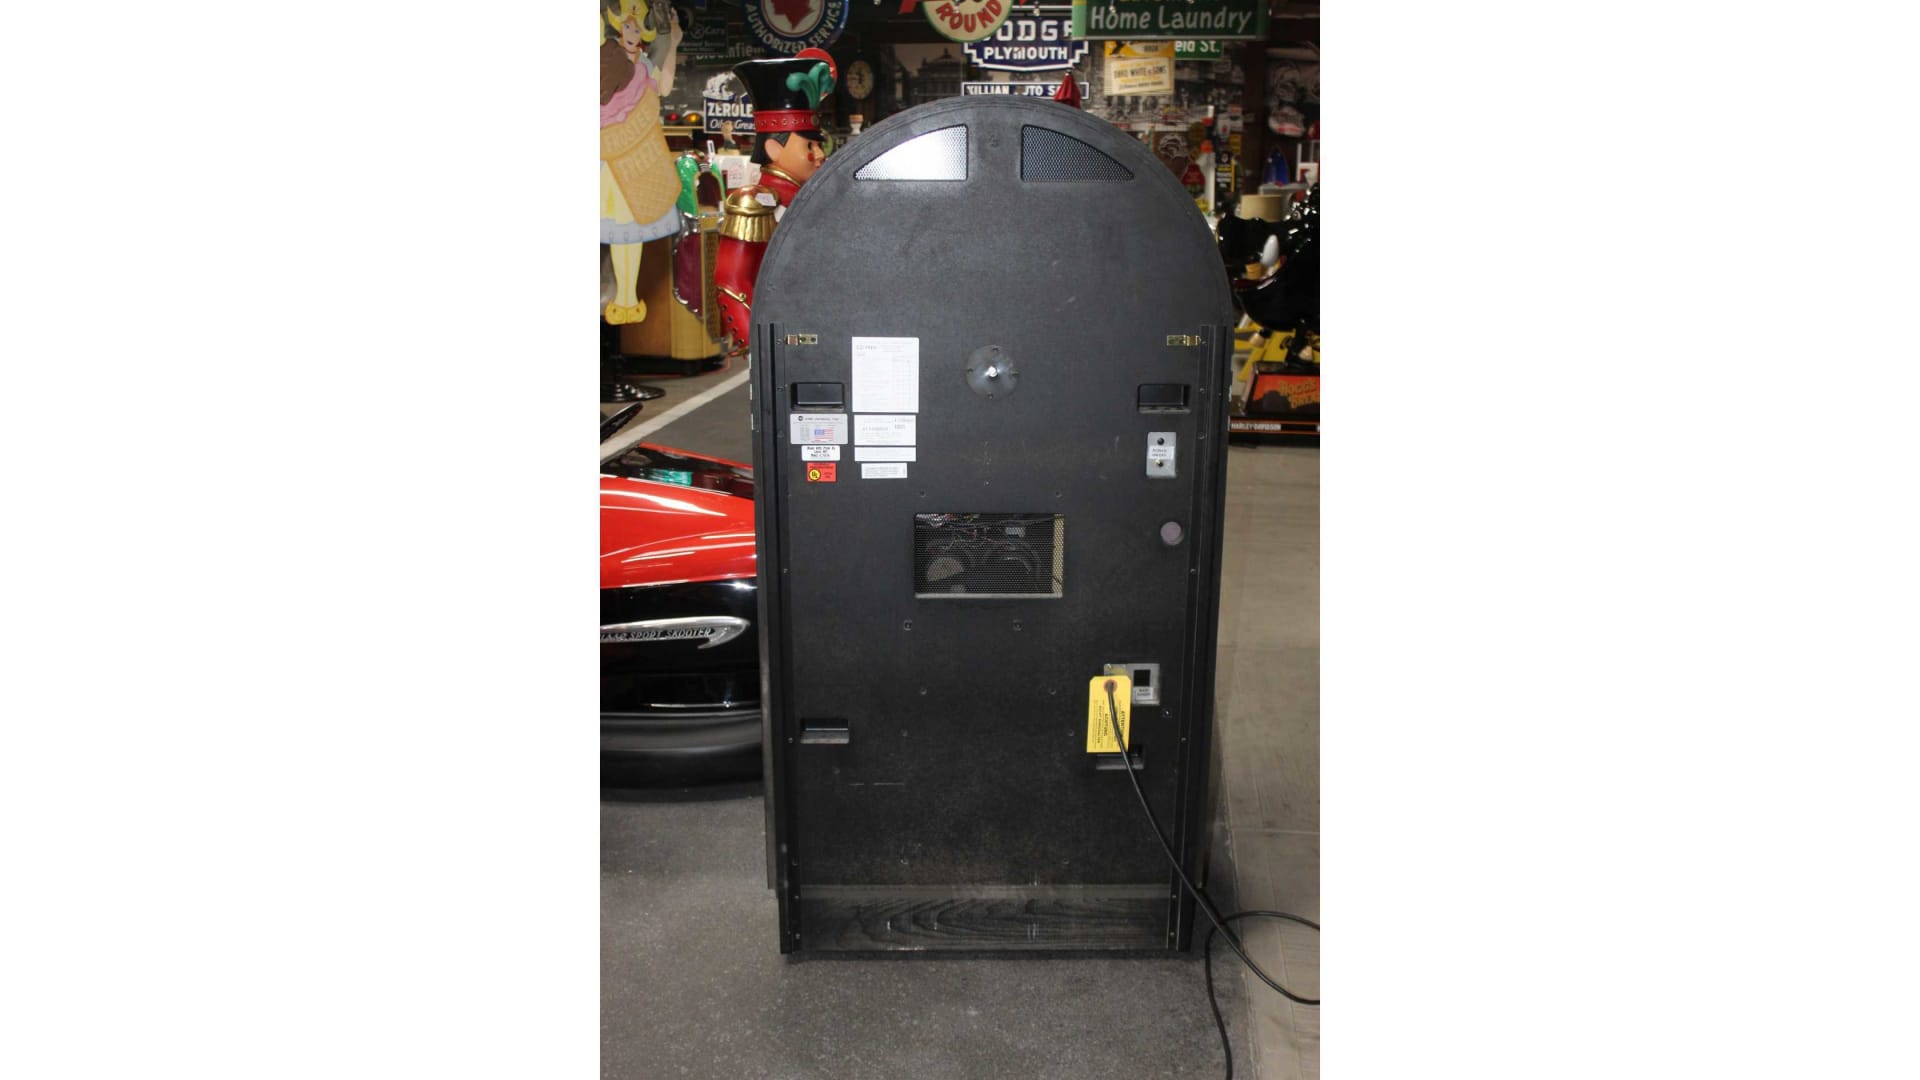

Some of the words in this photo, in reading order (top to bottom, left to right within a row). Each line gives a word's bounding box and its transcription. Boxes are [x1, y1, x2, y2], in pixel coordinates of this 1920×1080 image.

[935, 0, 1003, 33] ROUND
[1090, 5, 1150, 29] Home
[1158, 5, 1252, 33] Laundry
[745, 3, 807, 53] AUTHORIZED
[808, 1, 842, 48] SERVICE
[983, 19, 1073, 42] ODG
[983, 47, 1068, 60] PLYMOUTH
[1014, 85, 1043, 96] UTO
[707, 102, 754, 118] ZEROLE
[629, 630, 661, 640] SPORT
[666, 627, 713, 639] SKOOTER
